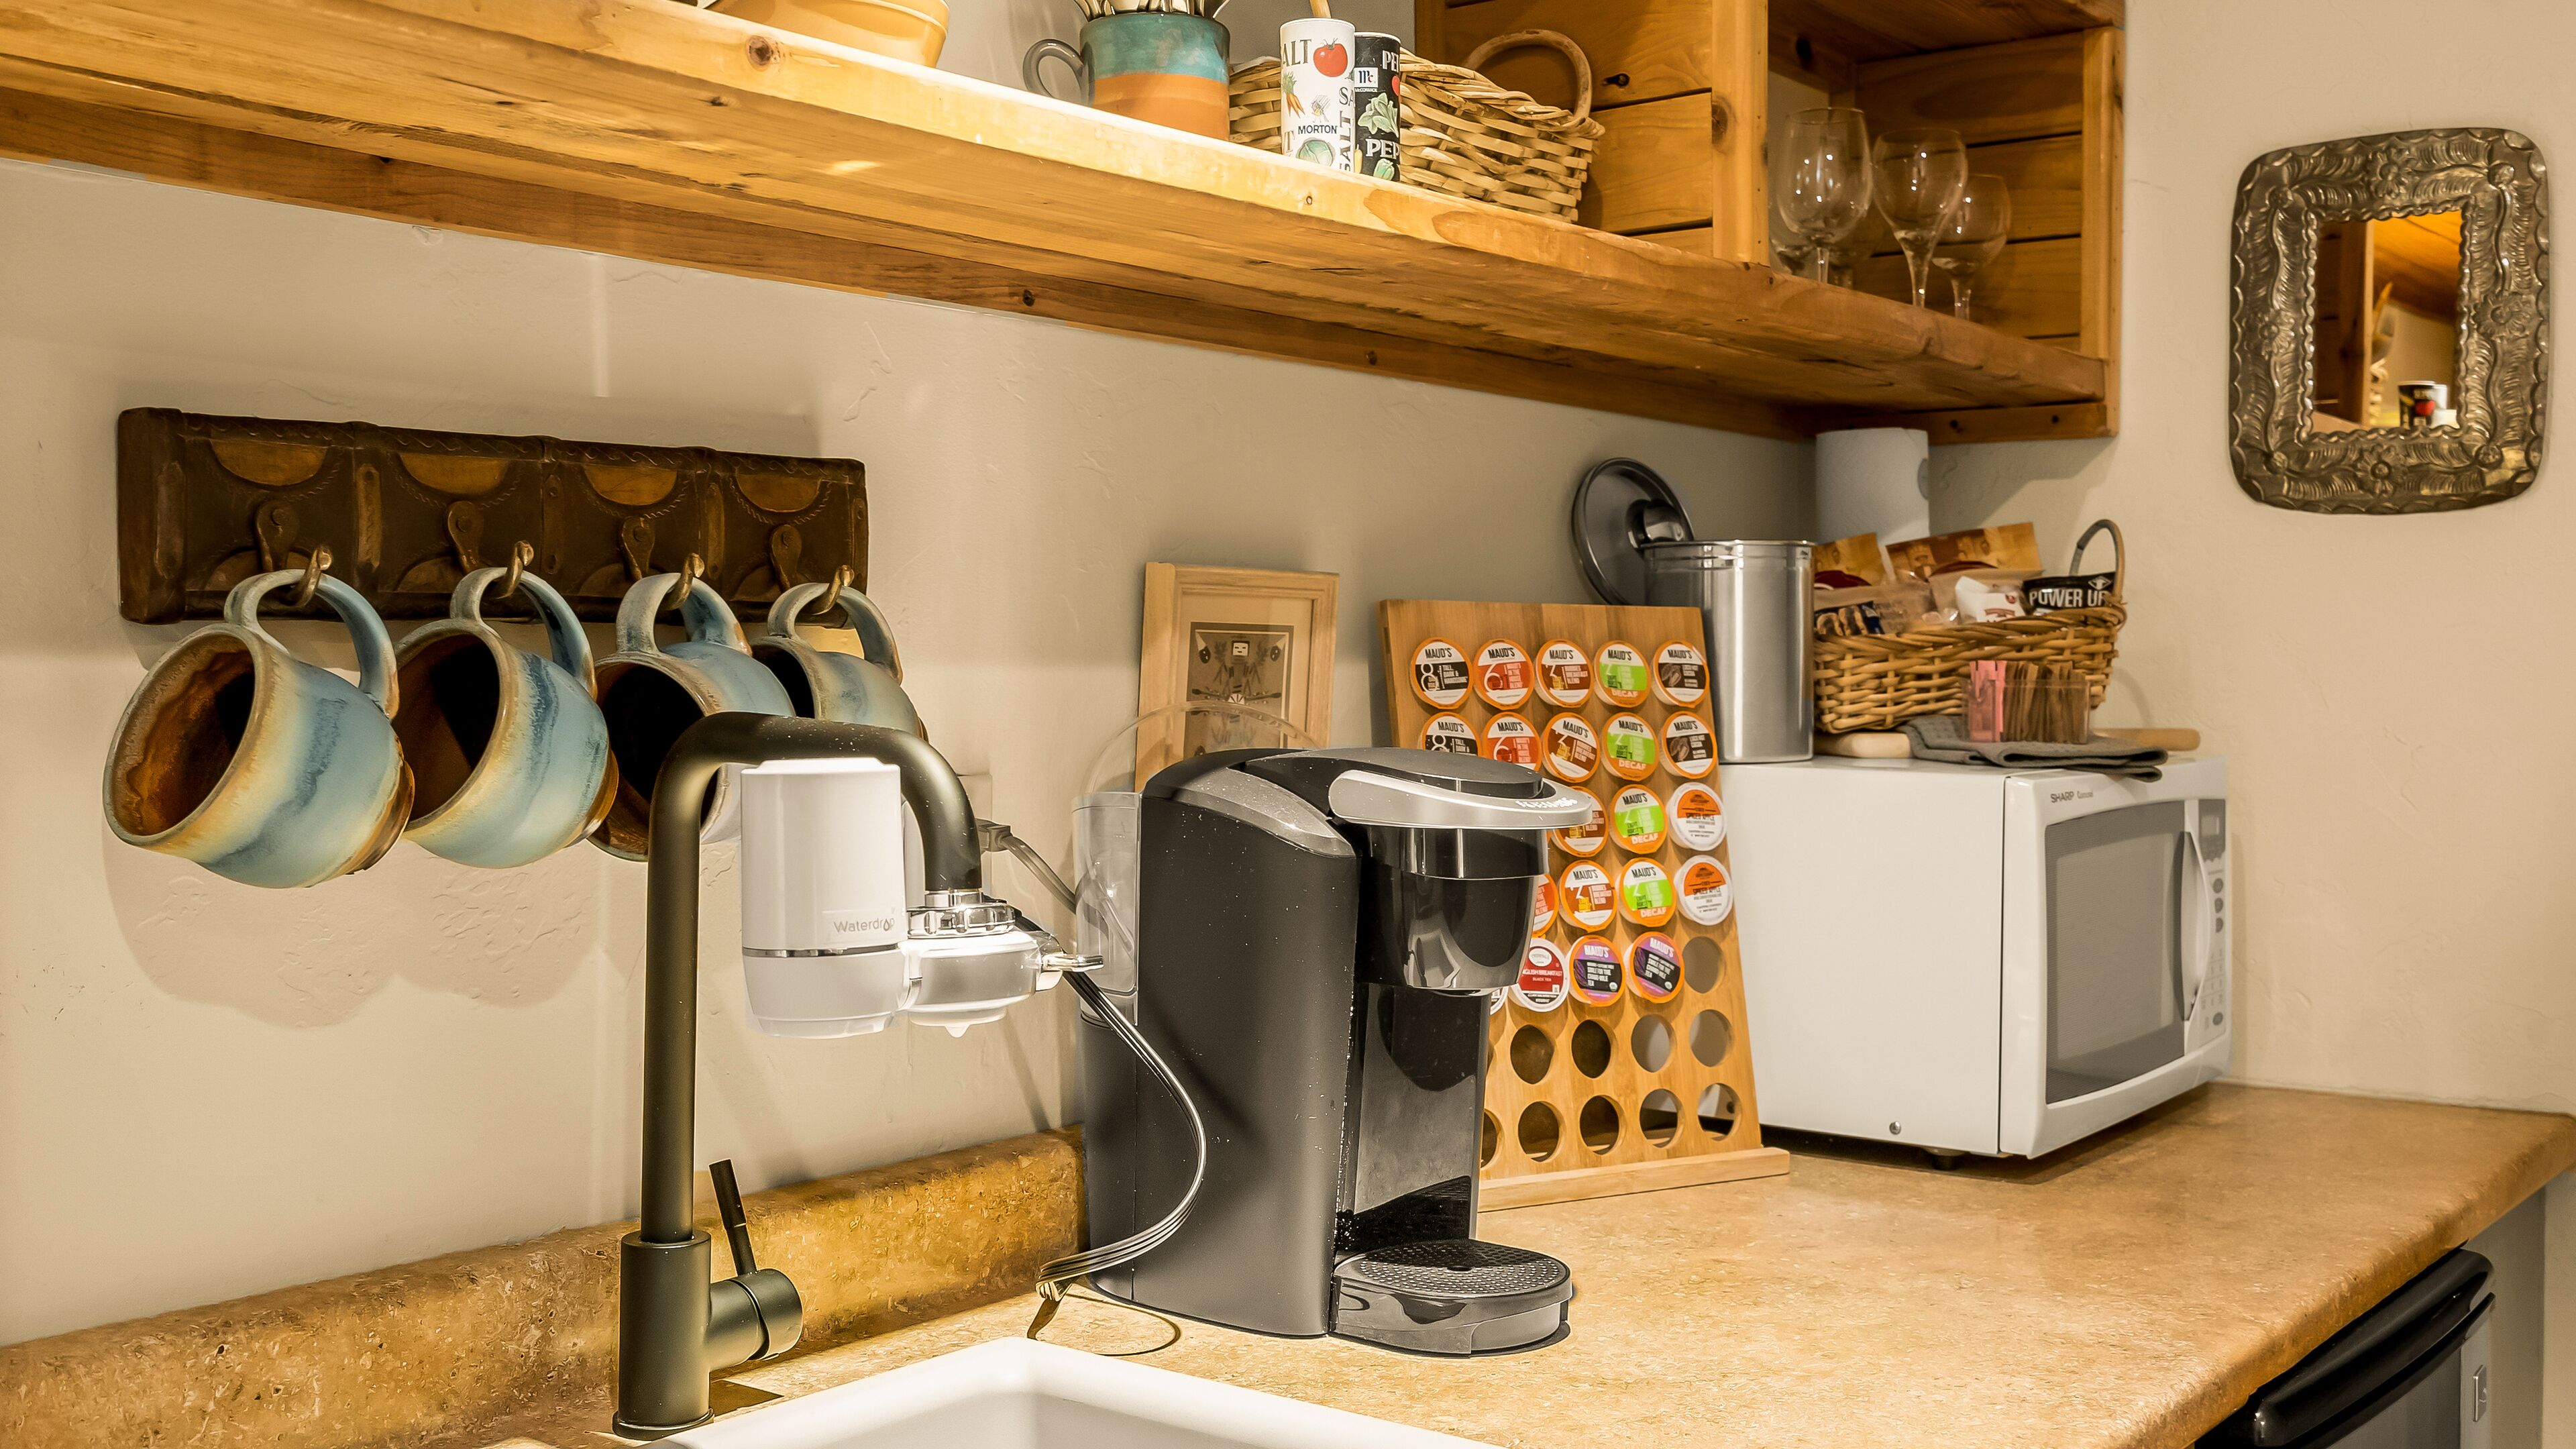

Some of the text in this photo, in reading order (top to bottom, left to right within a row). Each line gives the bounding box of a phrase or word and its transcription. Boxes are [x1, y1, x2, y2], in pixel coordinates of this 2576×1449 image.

[1282, 39, 1311, 67] ALT
[1298, 125, 1338, 134] MORTON
[1365, 138, 1399, 160] PEP
[2029, 588, 2083, 607] POWER
[1425, 648, 1452, 659] MAUD'S
[1488, 647, 1515, 659] MAUD'S
[1550, 649, 1573, 659] MAUD'S
[1608, 649, 1631, 661] MAUD'S
[1668, 649, 1692, 659] MAUD'S
[1611, 688, 1638, 698] DECAF
[1438, 721, 1464, 733] MAUD'S
[1497, 722, 1524, 732] MAUD'S
[1563, 720, 1589, 738] MAUD'S
[1619, 720, 1644, 733] MAUD'S
[1674, 721, 1698, 731] MAUD'S
[1619, 759, 1646, 770] DECAF
[1622, 793, 1648, 805] MAUD'S
[2050, 791, 2074, 803] SHARP
[1631, 833, 1659, 845] DECAF
[1573, 869, 1598, 880] MAUD'S
[1631, 867, 1656, 878] MAUD'S
[1640, 907, 1667, 918] DECAF
[1584, 945, 1610, 957] MAUD'S
[1650, 937, 1675, 957] MAUD'S
